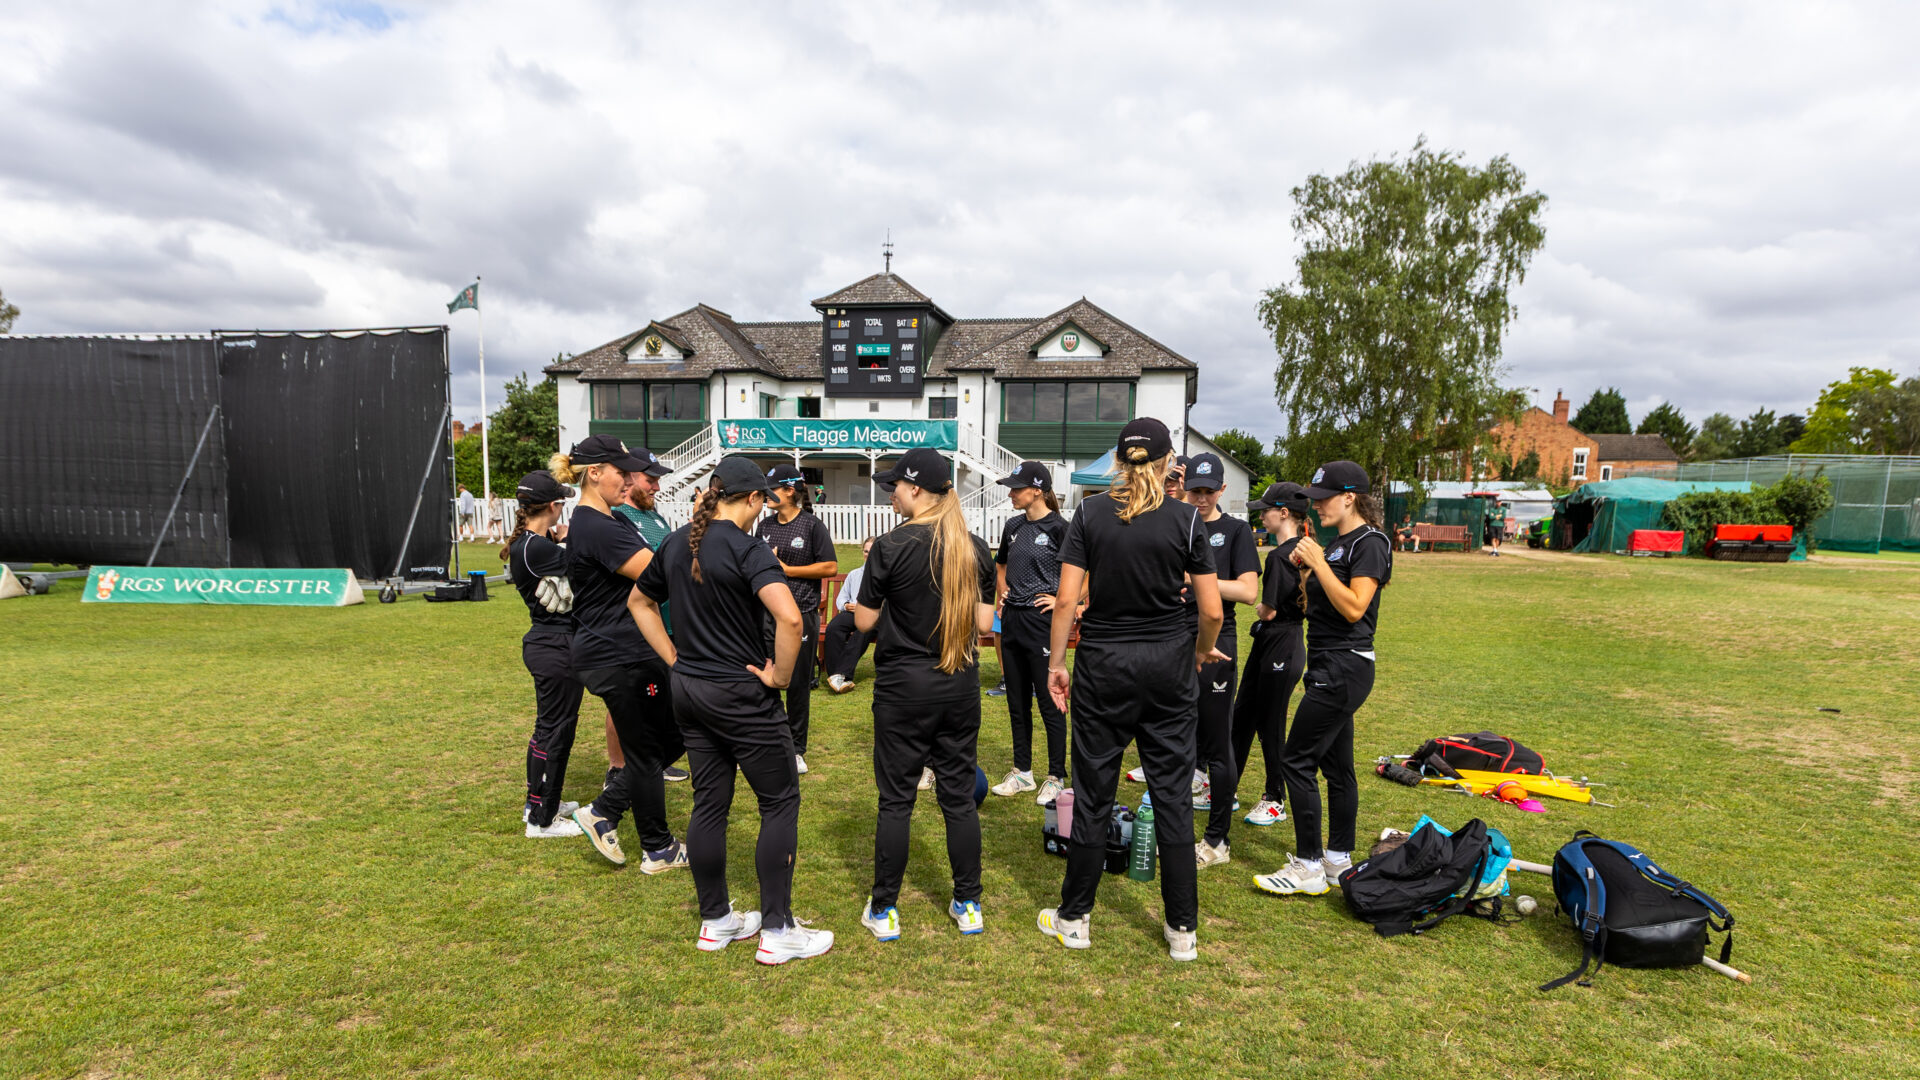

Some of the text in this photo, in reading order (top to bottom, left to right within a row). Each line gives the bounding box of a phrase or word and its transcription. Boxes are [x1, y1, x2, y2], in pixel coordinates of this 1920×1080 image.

[841, 320, 850, 328] BAT
[864, 318, 883, 326] TOTAL
[897, 318, 918, 328] BAT 2
[899, 366, 916, 374] OVERS
[877, 374, 892, 382] WKTS
[741, 427, 766, 440] RGS
[793, 426, 927, 446] Flagge Meadow
[119, 577, 333, 595] RGS WORCESTER
